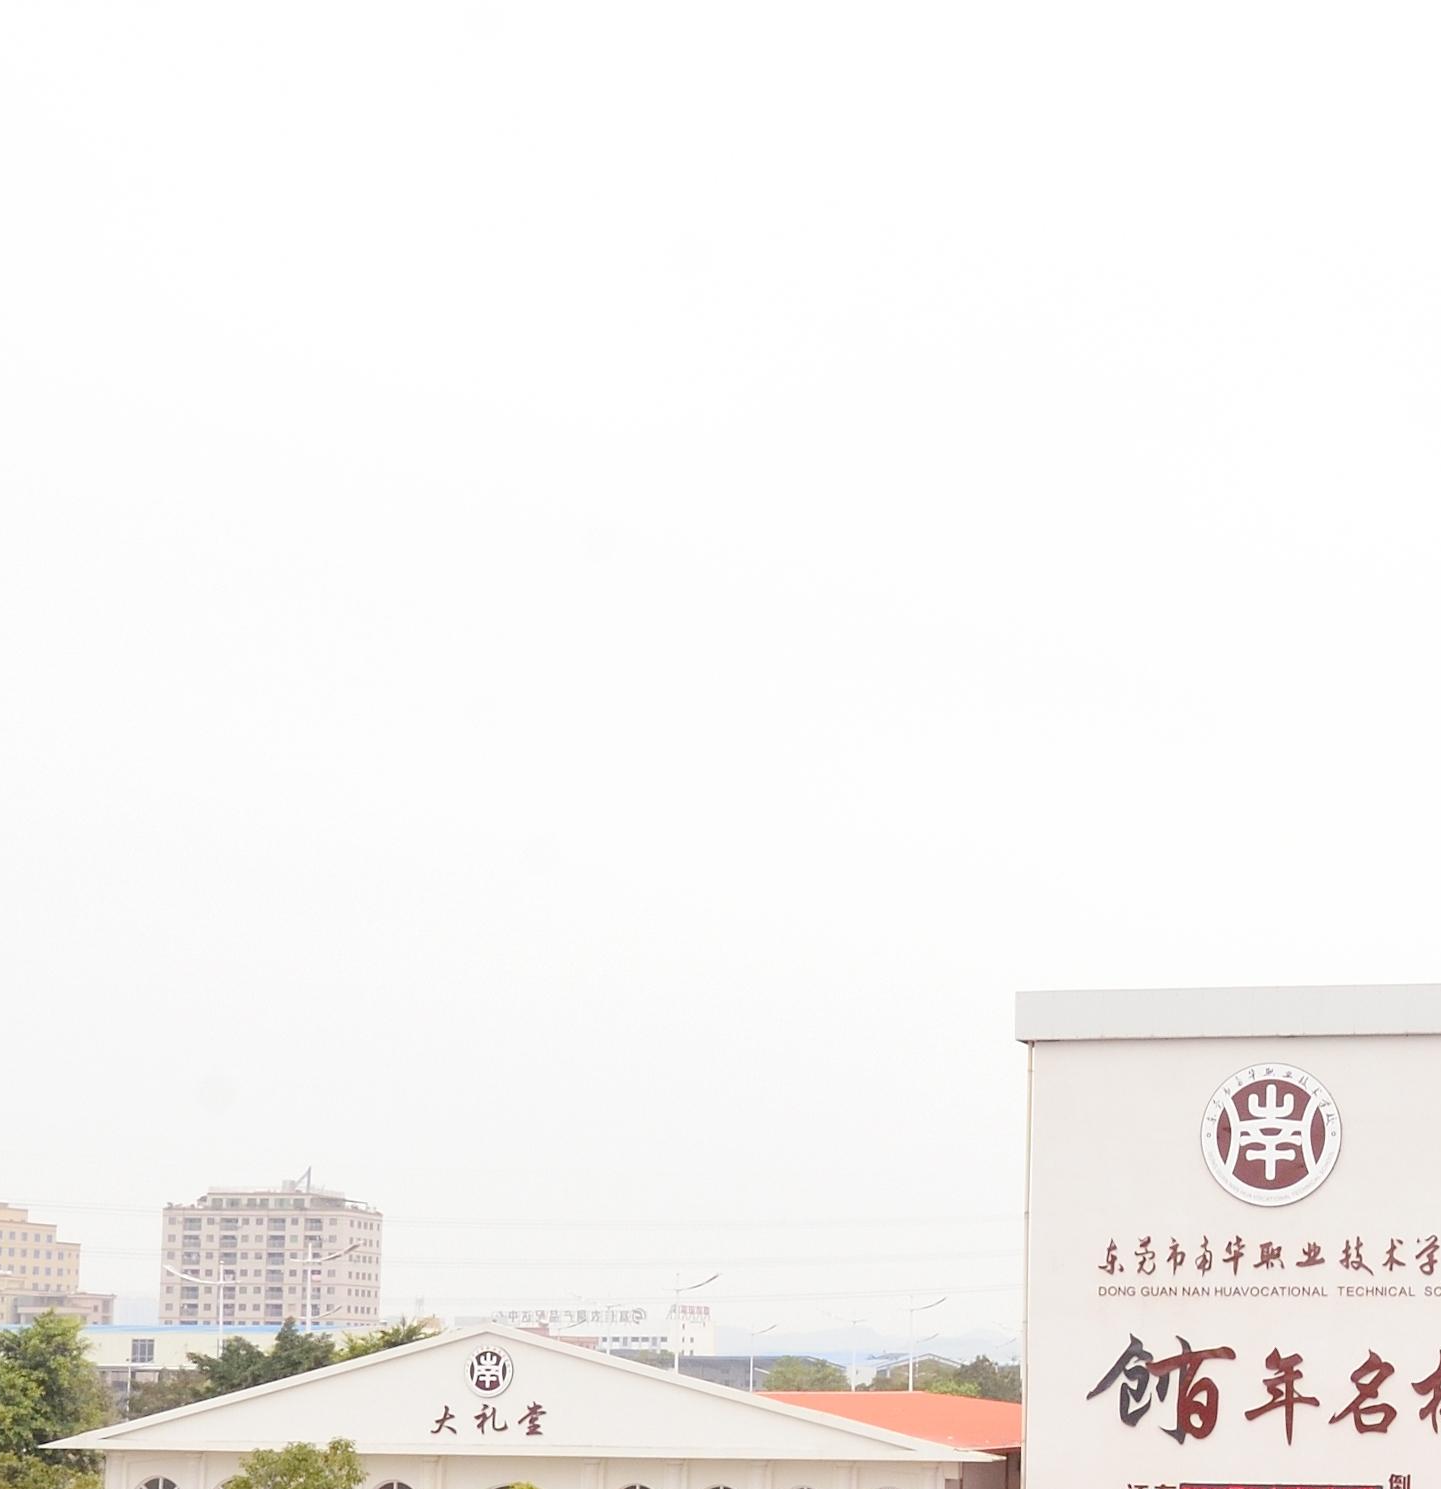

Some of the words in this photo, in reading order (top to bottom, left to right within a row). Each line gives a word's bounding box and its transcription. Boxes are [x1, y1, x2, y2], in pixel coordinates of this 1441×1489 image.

[1098, 1286, 1136, 1297] DONG
[1141, 1286, 1178, 1297] GUAN
[1182, 1286, 1210, 1297] NAN
[1338, 1286, 1415, 1297] TECHNICAL
[430, 1401, 547, 1436] 大礼堂
